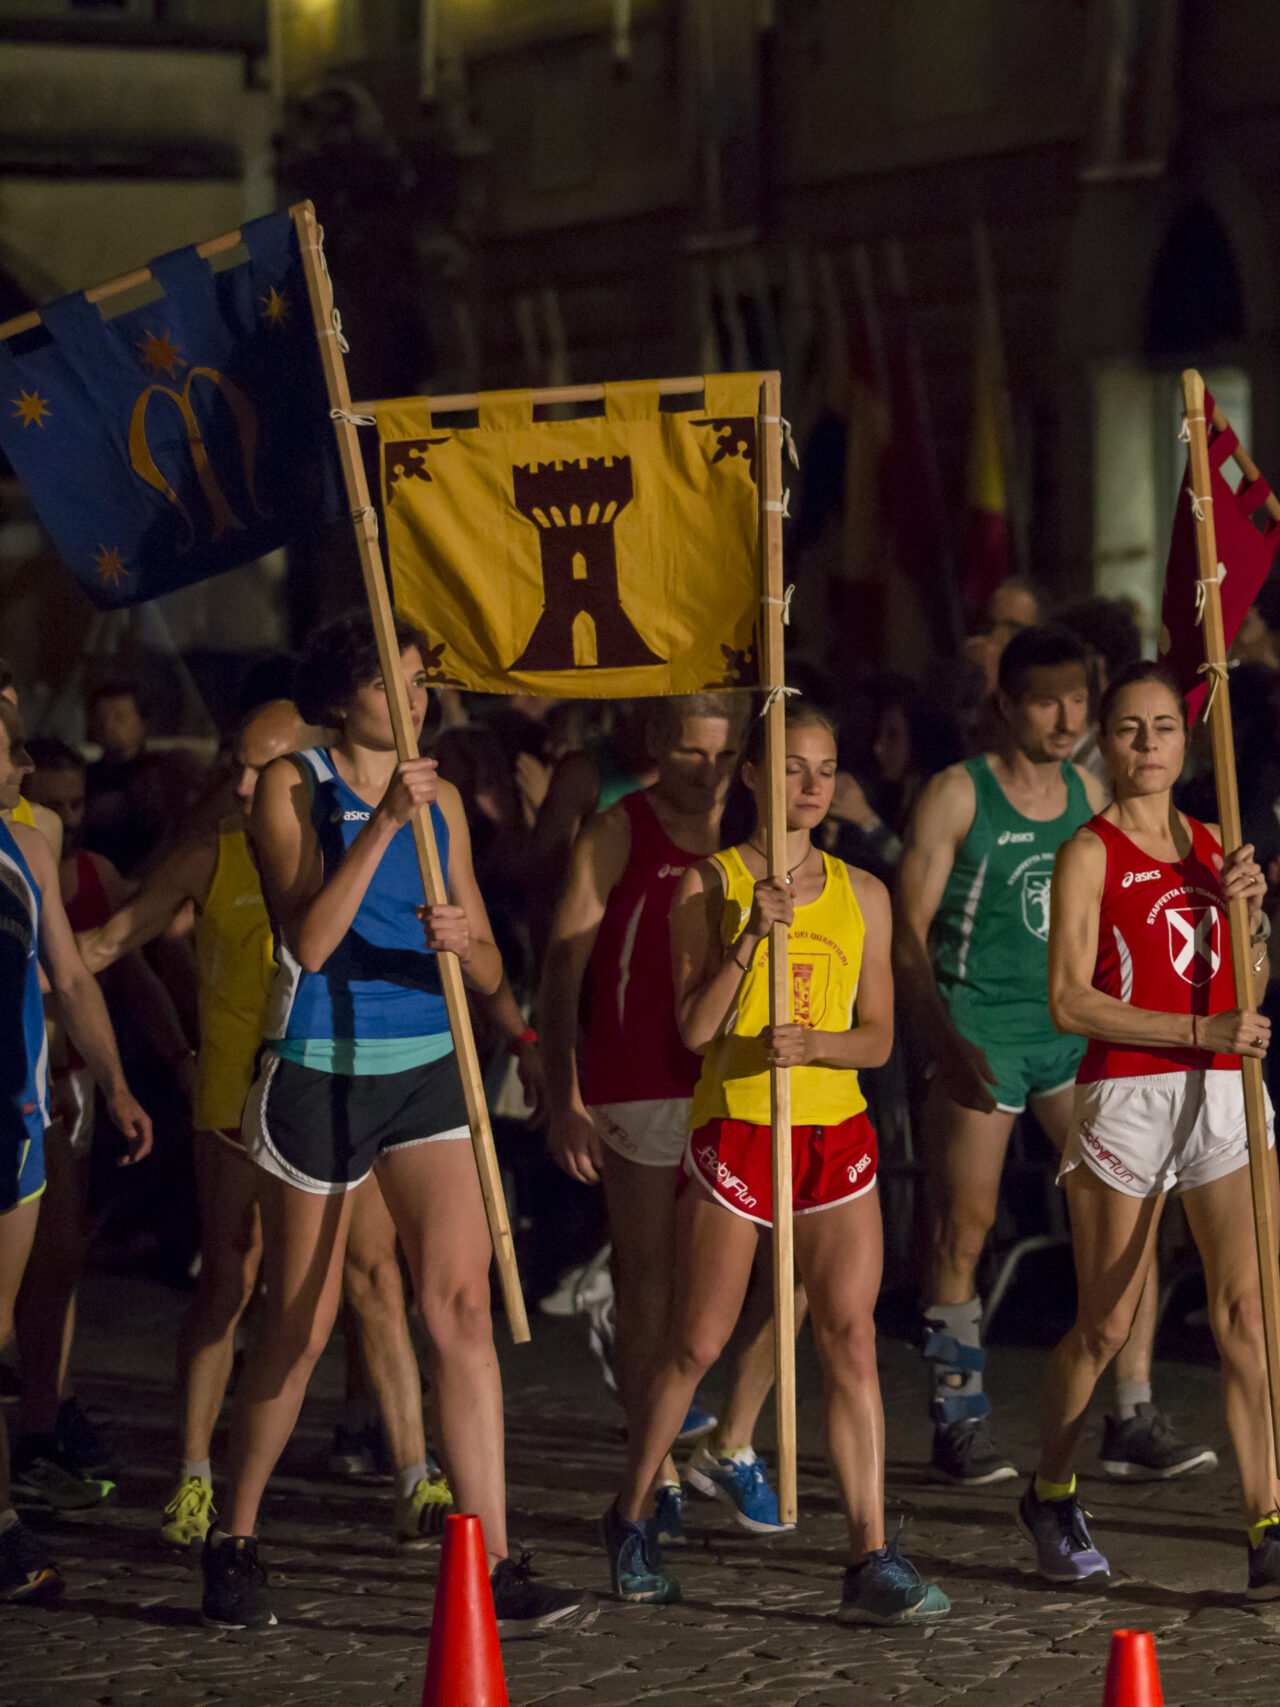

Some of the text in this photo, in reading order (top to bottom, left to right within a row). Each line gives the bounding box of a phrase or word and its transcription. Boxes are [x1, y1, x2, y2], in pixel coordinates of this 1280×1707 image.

[343, 810, 370, 821] asics
[1134, 869, 1162, 883] asics
[1146, 888, 1181, 925] STAFFETTA
[854, 1152, 872, 1173] asics
